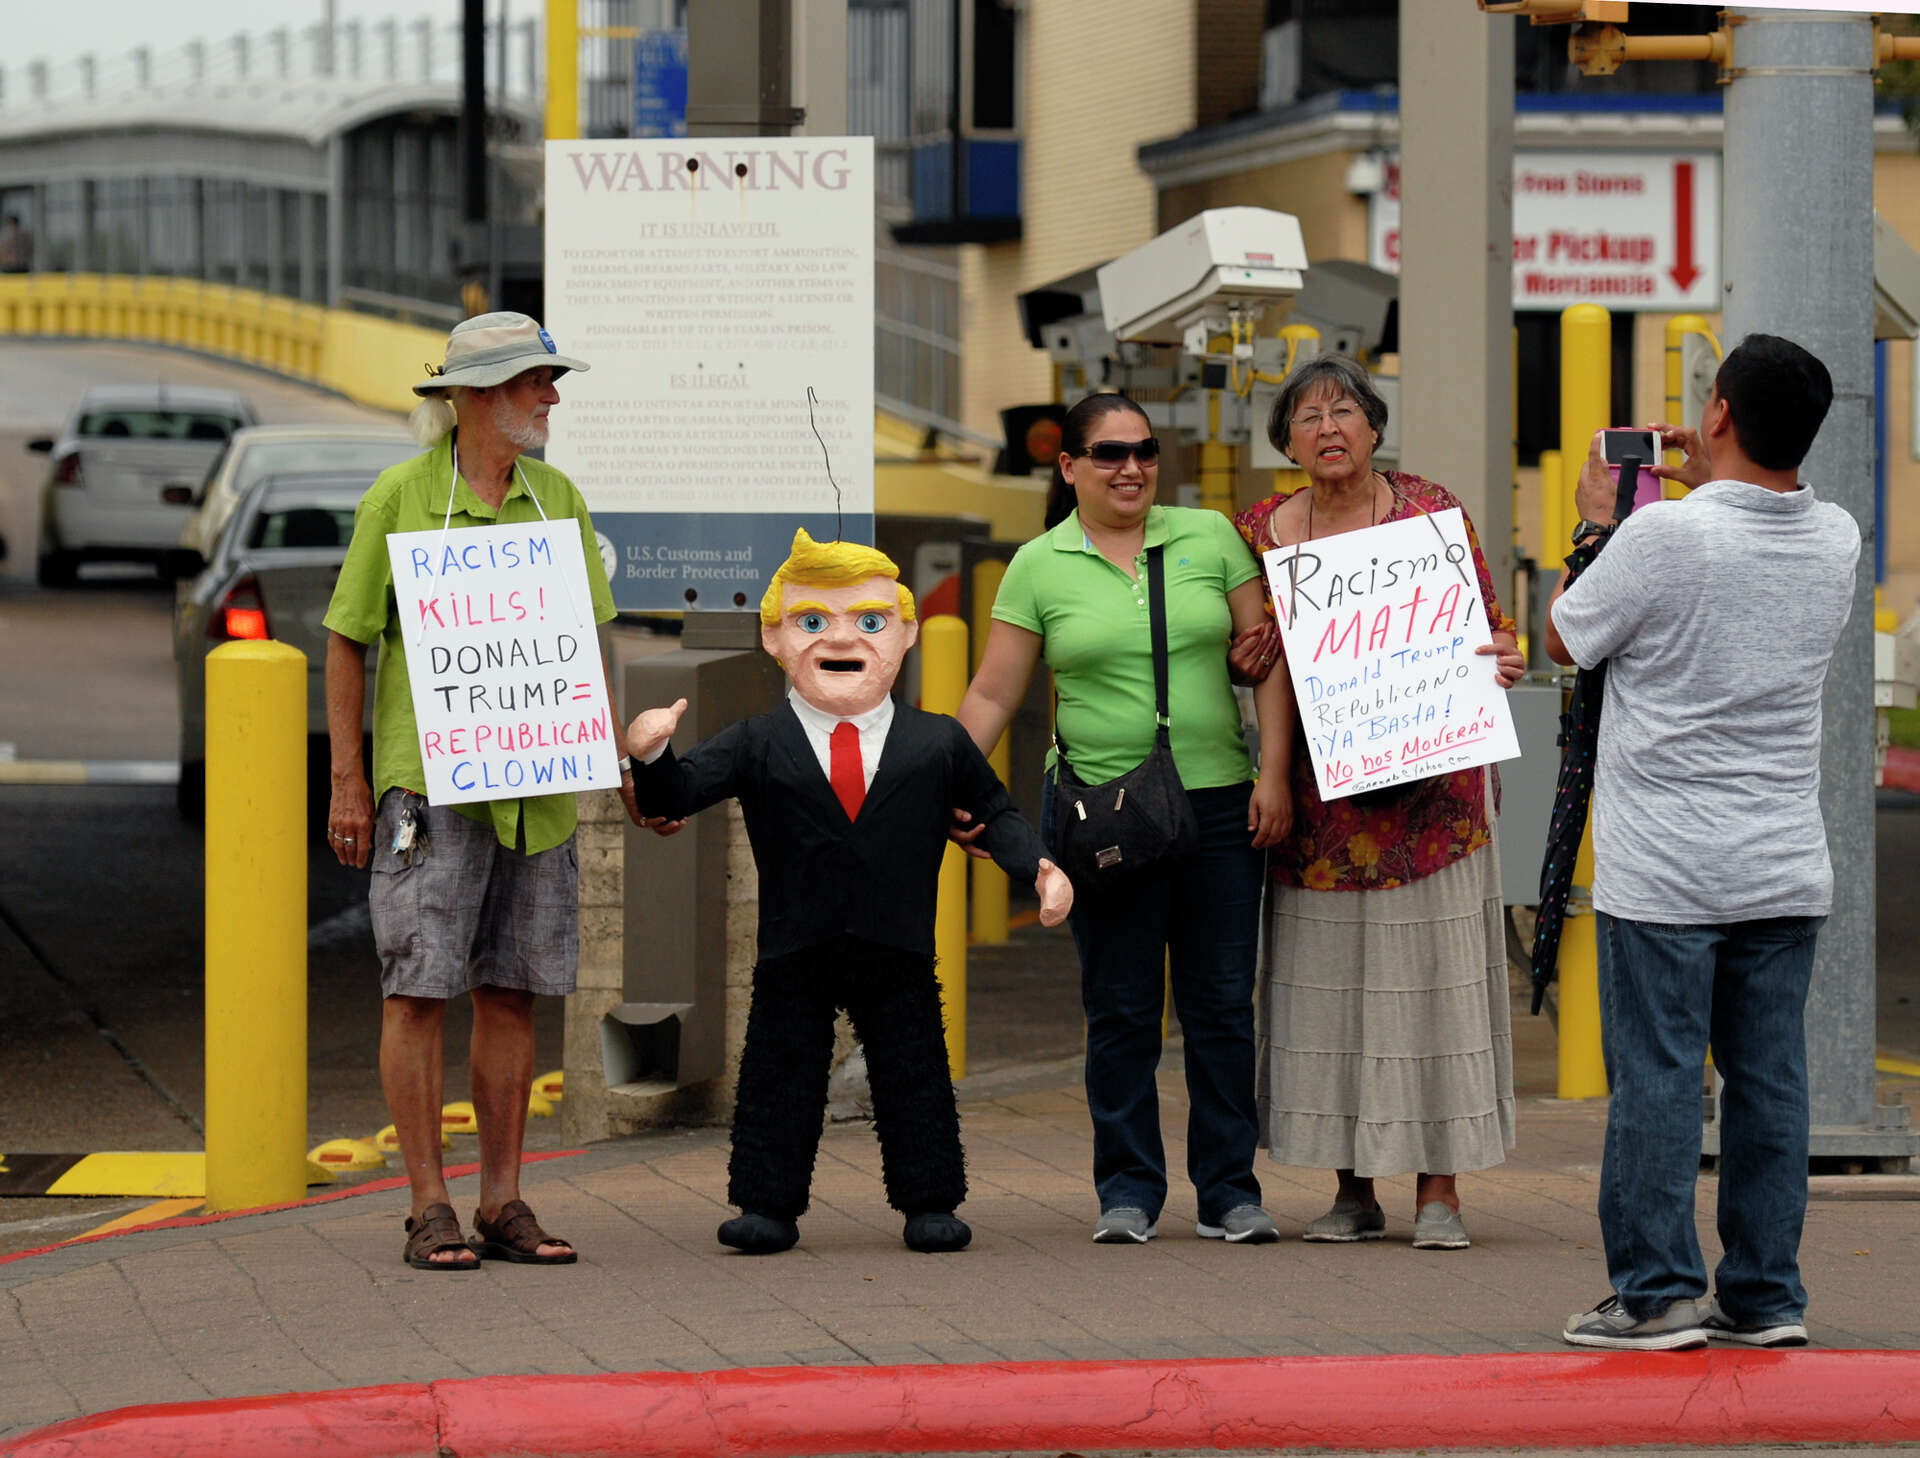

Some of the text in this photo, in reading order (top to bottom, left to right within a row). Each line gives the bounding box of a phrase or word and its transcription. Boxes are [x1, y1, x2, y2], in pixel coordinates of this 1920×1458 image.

[567, 149, 852, 192] WARNING
[640, 222, 780, 239] IT IS UNLAWFUL
[1547, 231, 1655, 264] Pickup
[670, 375, 750, 390] ES ILEGAL
[626, 546, 752, 561] U.S. Customs and
[626, 564, 760, 580] Border Protection
[431, 634, 577, 674] DONALD
[451, 754, 593, 791] CLOWN!
